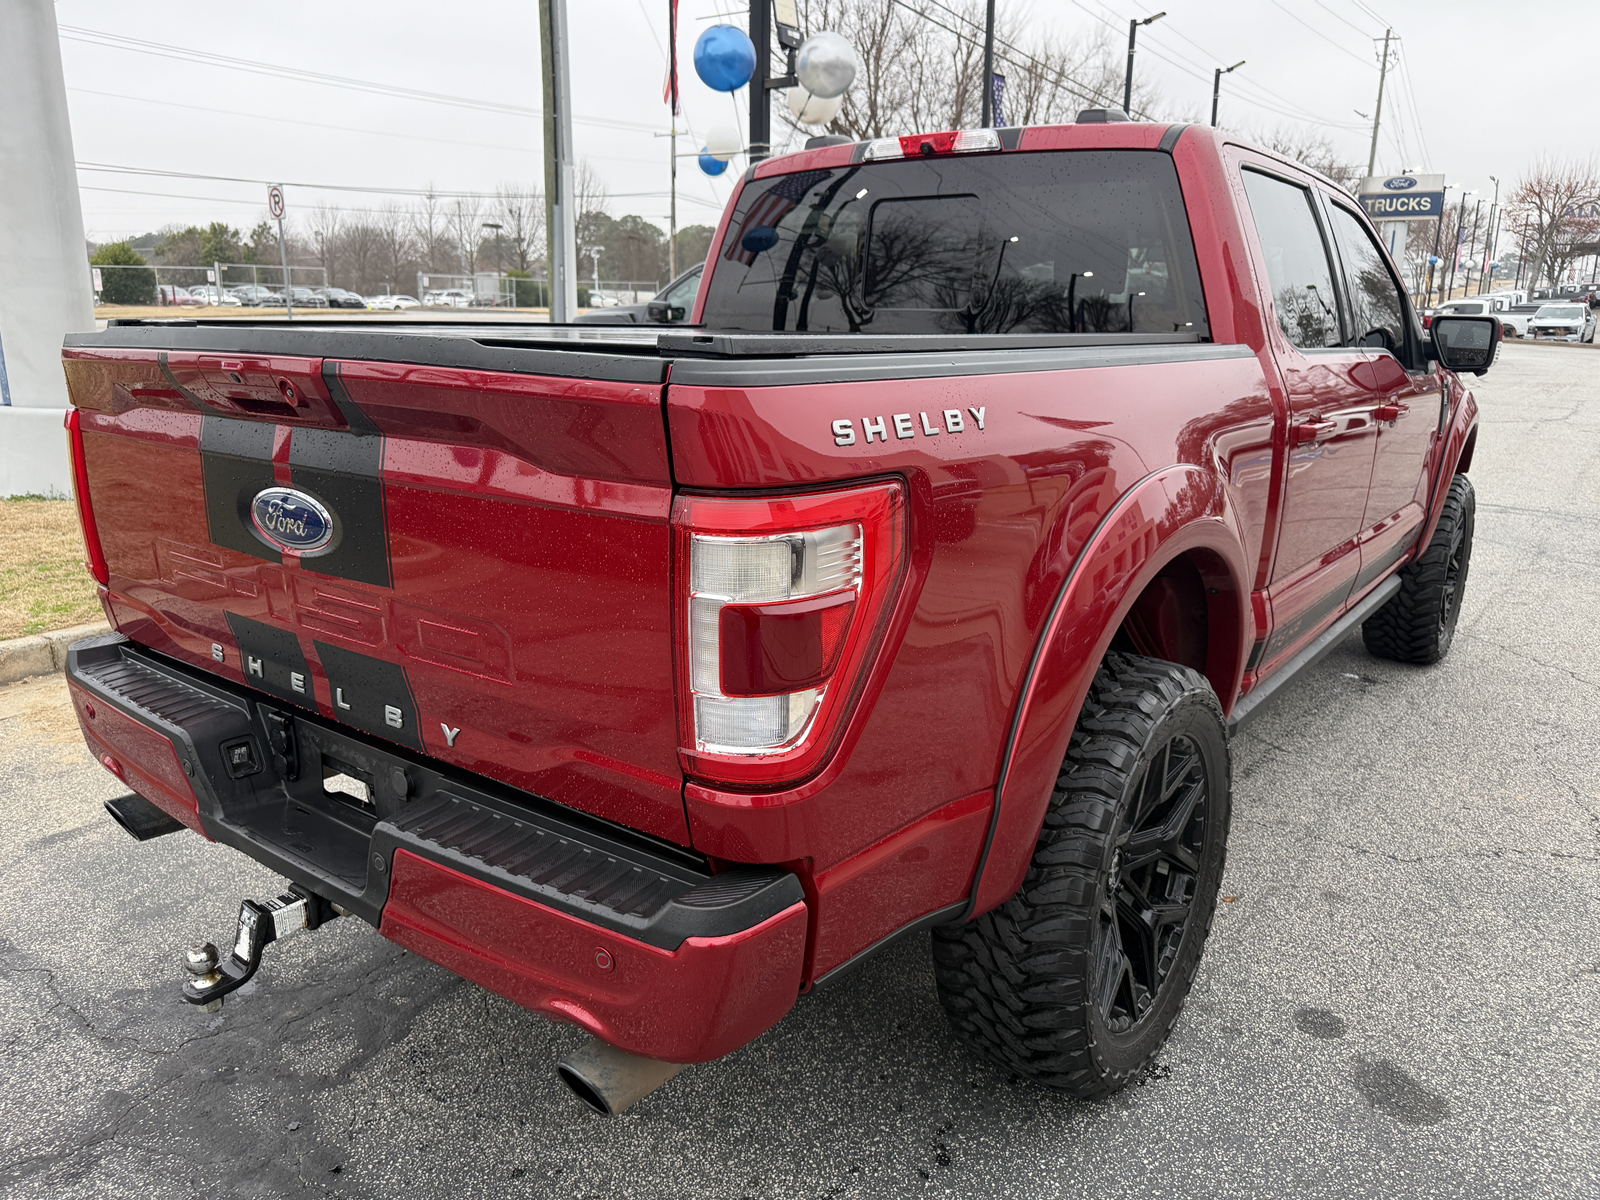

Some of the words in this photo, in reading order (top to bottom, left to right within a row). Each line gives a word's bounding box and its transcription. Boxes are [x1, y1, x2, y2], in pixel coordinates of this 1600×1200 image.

[1365, 197, 1432, 213] TRUCKS
[831, 406, 986, 447] SHELBY
[265, 499, 309, 537] Ford
[152, 536, 516, 687] F-150
[210, 642, 460, 748] SHELBY
